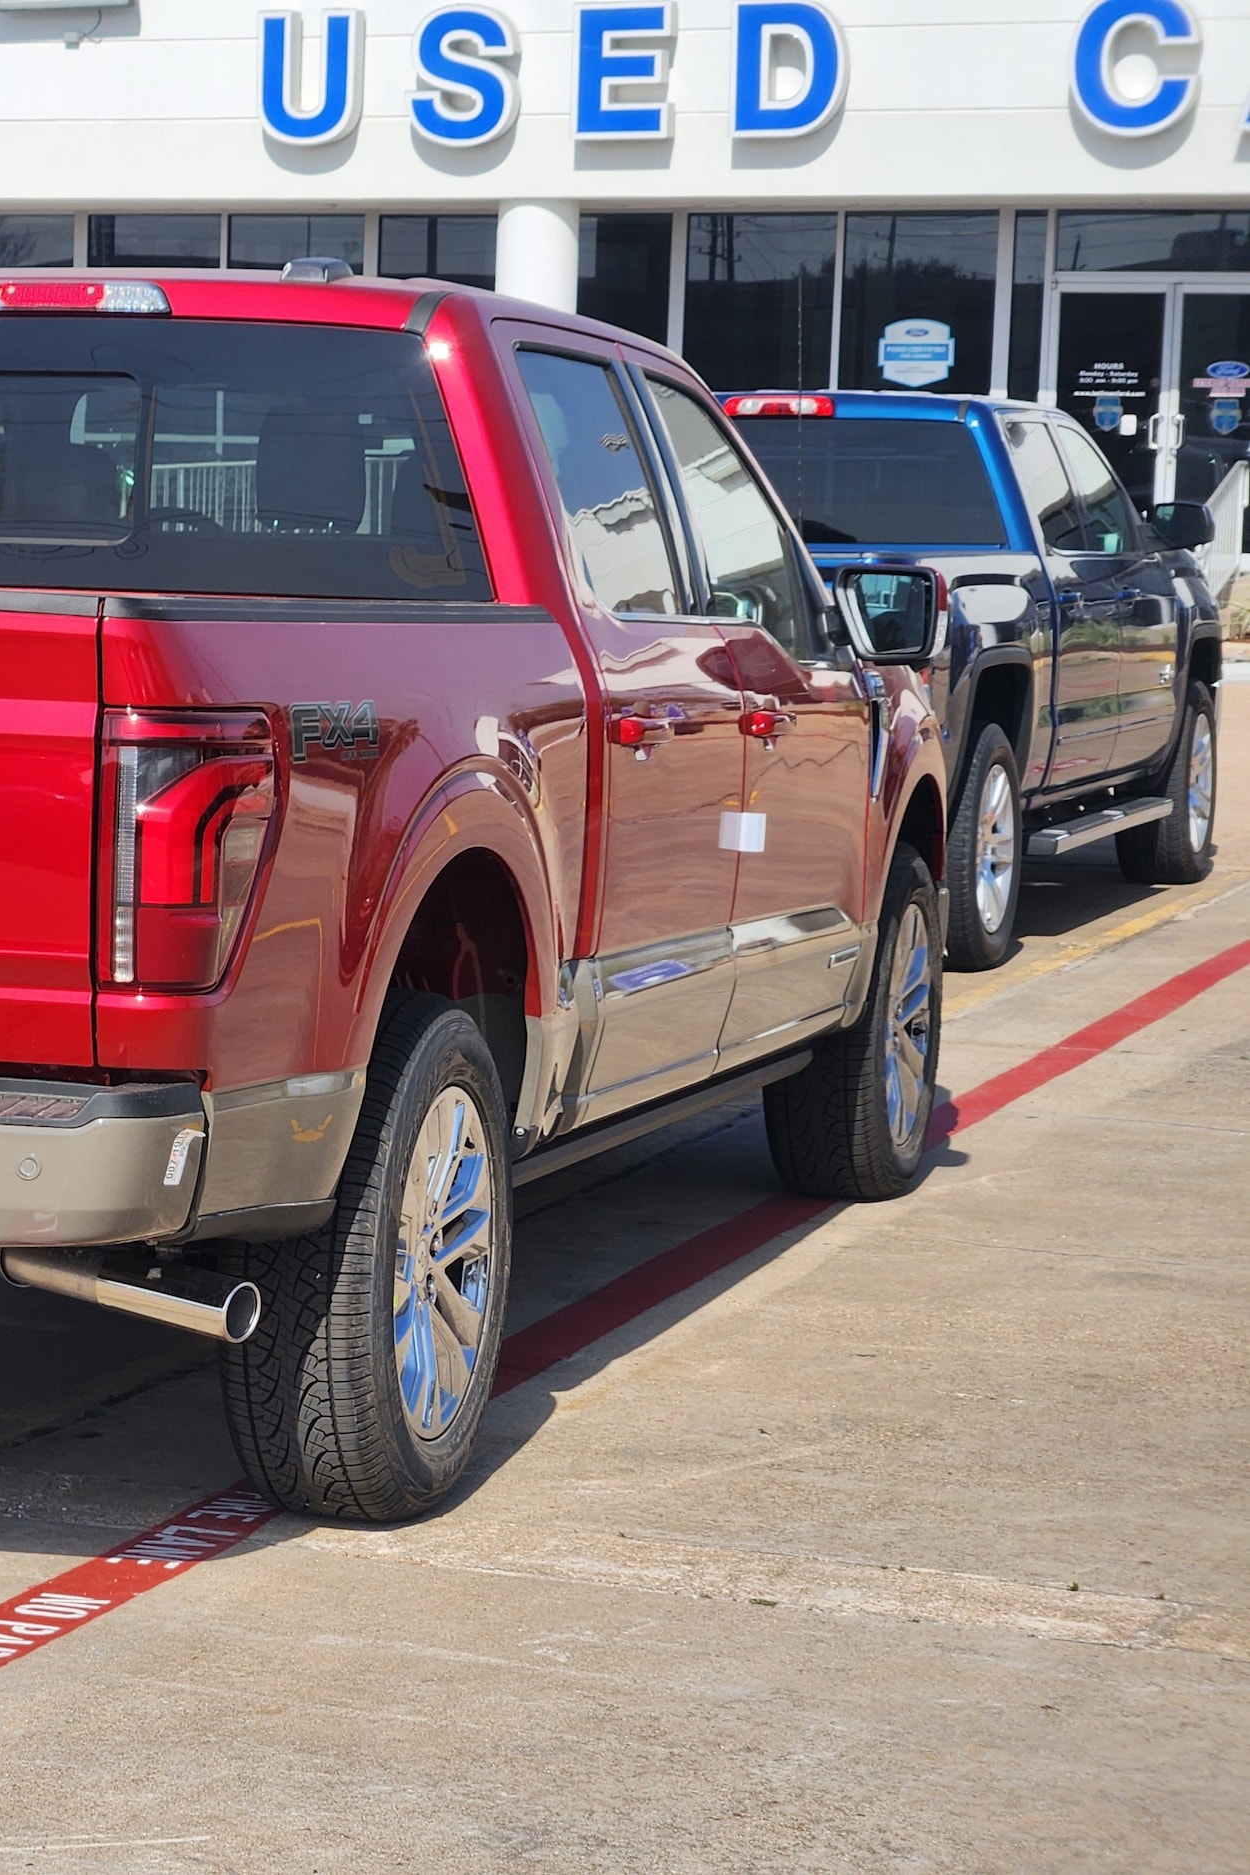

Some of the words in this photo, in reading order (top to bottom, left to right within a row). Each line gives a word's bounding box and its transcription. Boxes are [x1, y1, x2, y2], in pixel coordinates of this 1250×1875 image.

[260, 2, 842, 145] USED
[1072, 0, 1250, 136] C
[1094, 362, 1124, 370] HOURS
[1109, 370, 1139, 378] Saturday
[288, 700, 380, 764] FX4
[105, 1524, 238, 1570] LANE
[14, 1592, 111, 1619] NO
